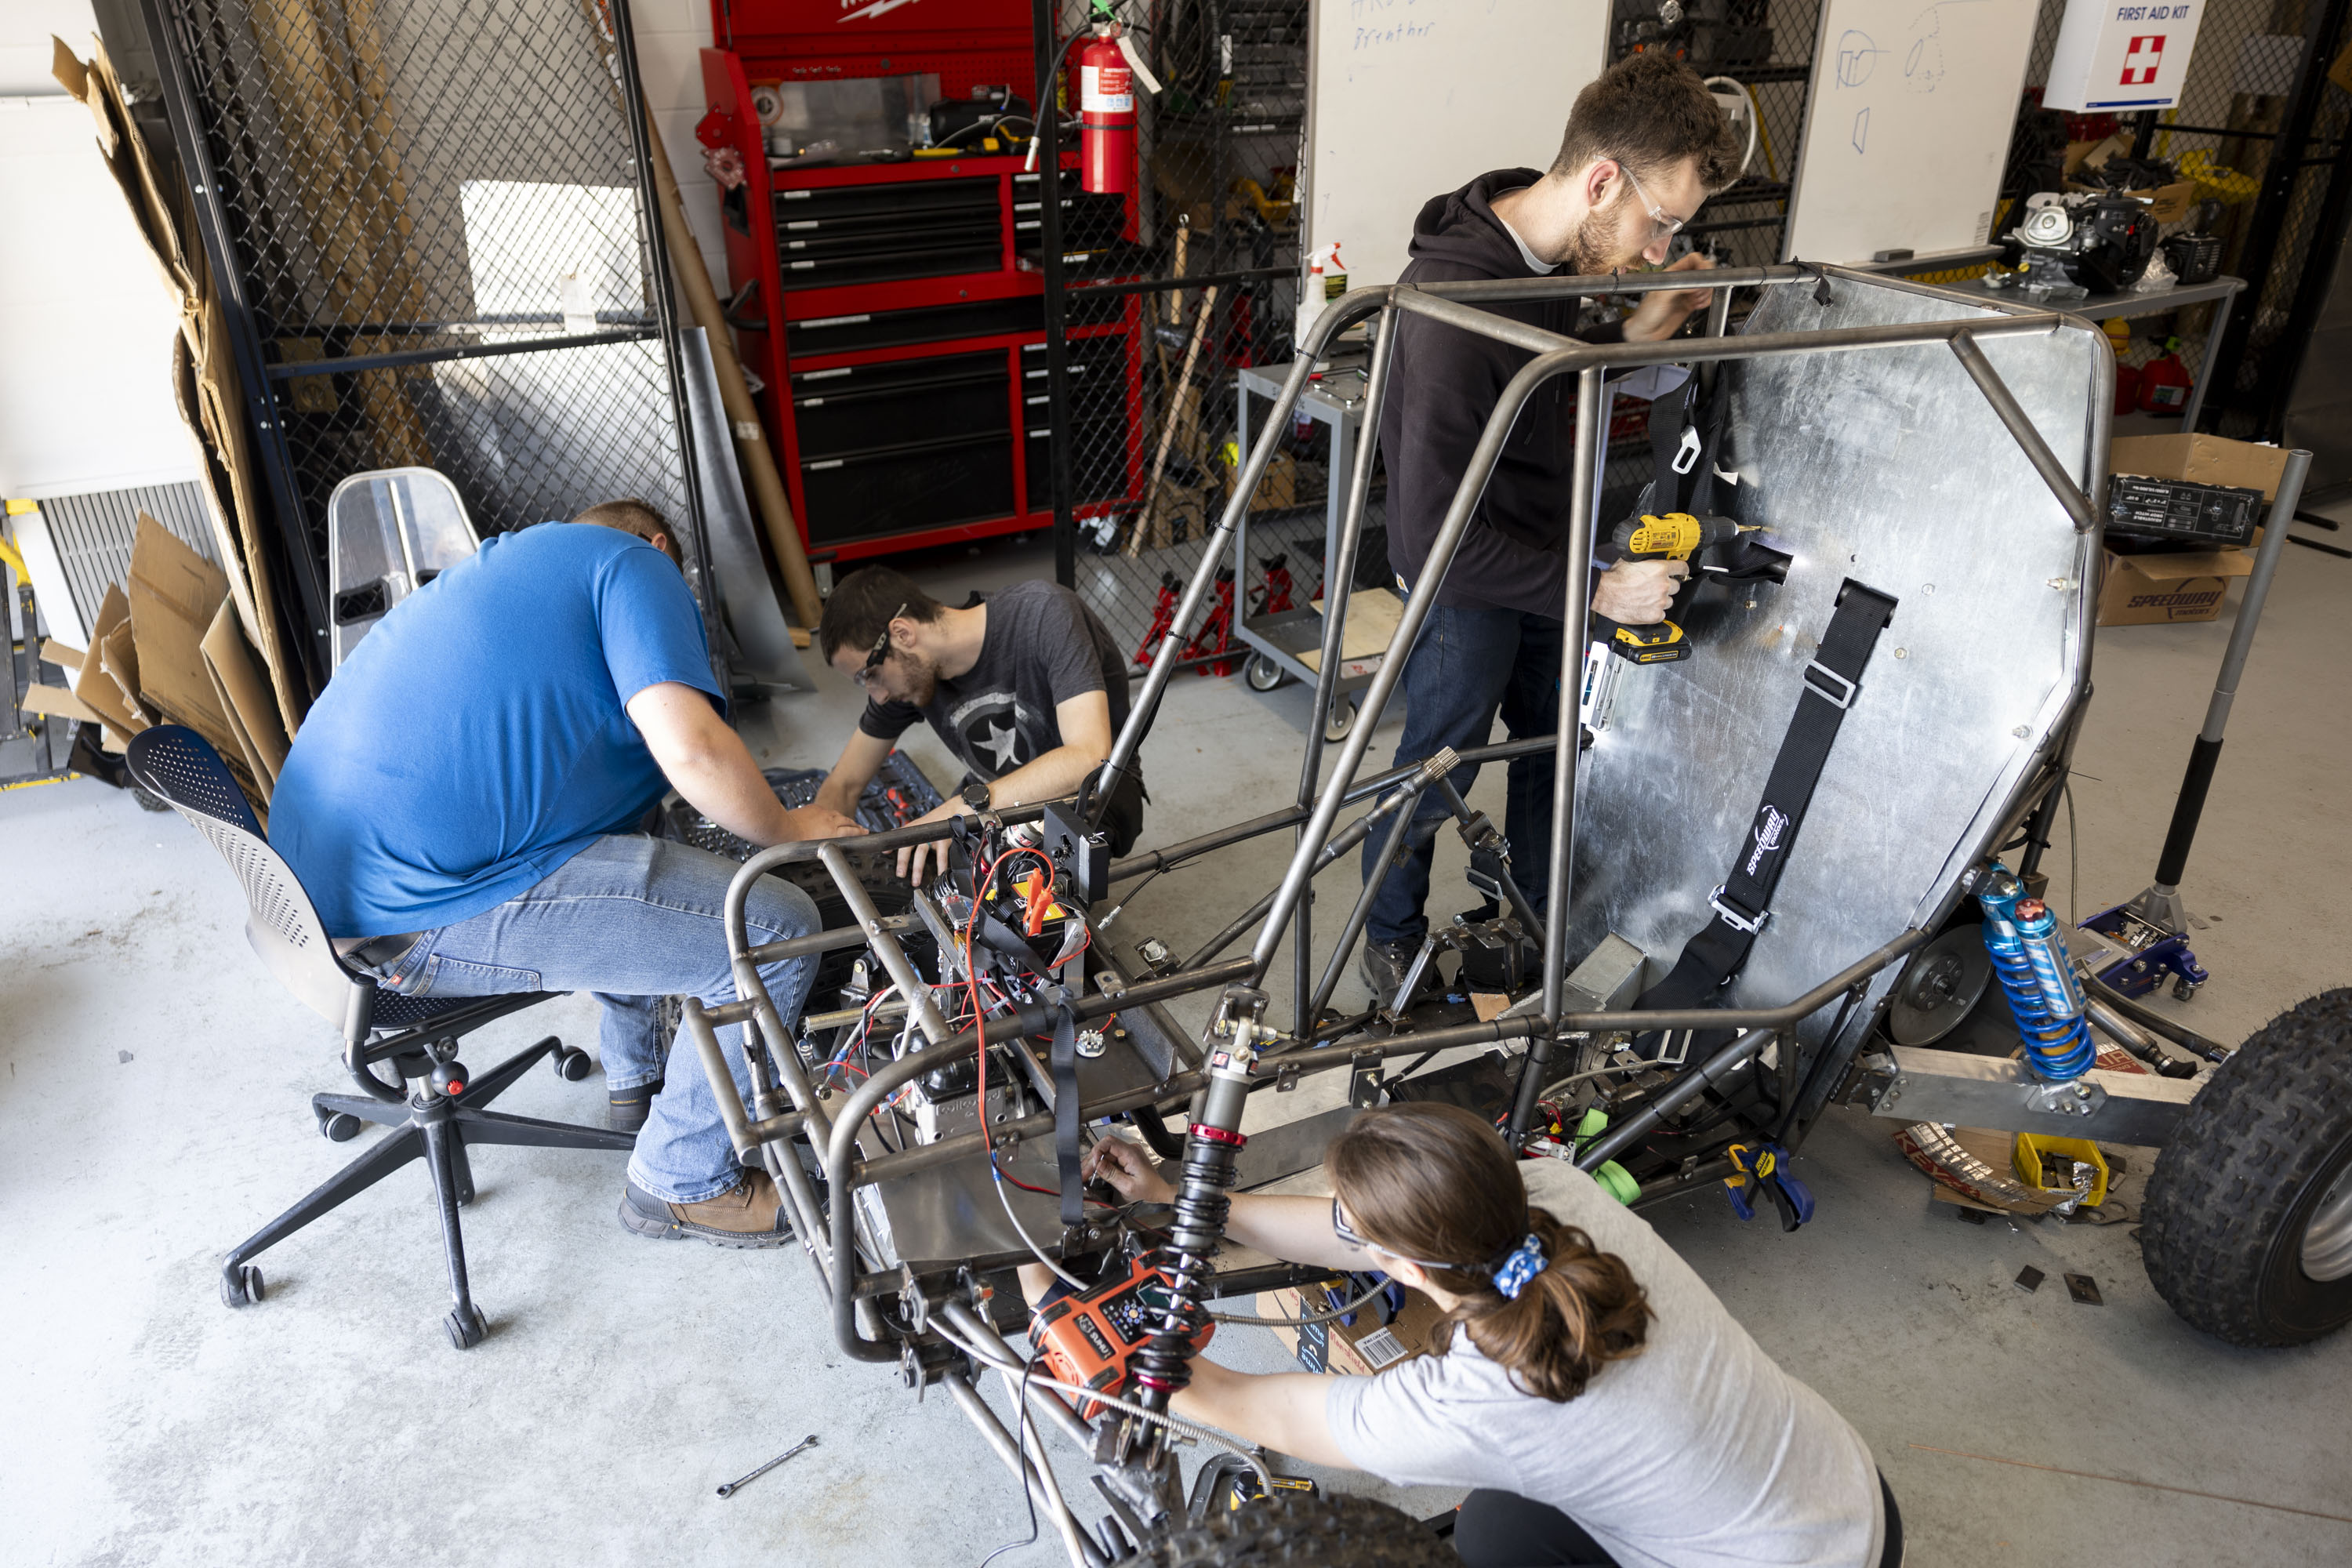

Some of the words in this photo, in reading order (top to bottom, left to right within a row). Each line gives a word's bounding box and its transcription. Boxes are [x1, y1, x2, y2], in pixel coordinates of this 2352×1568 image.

[2117, 6, 2147, 20] FIRST
[2148, 5, 2169, 20] AID
[2172, 5, 2190, 19] KIT
[2127, 590, 2223, 608] SPEEDWAY
[2174, 608, 2211, 616] motors
[1746, 808, 1780, 876] SPEEDWAY
[1770, 818, 1784, 846] motors
[2025, 946, 2069, 1012] KING
